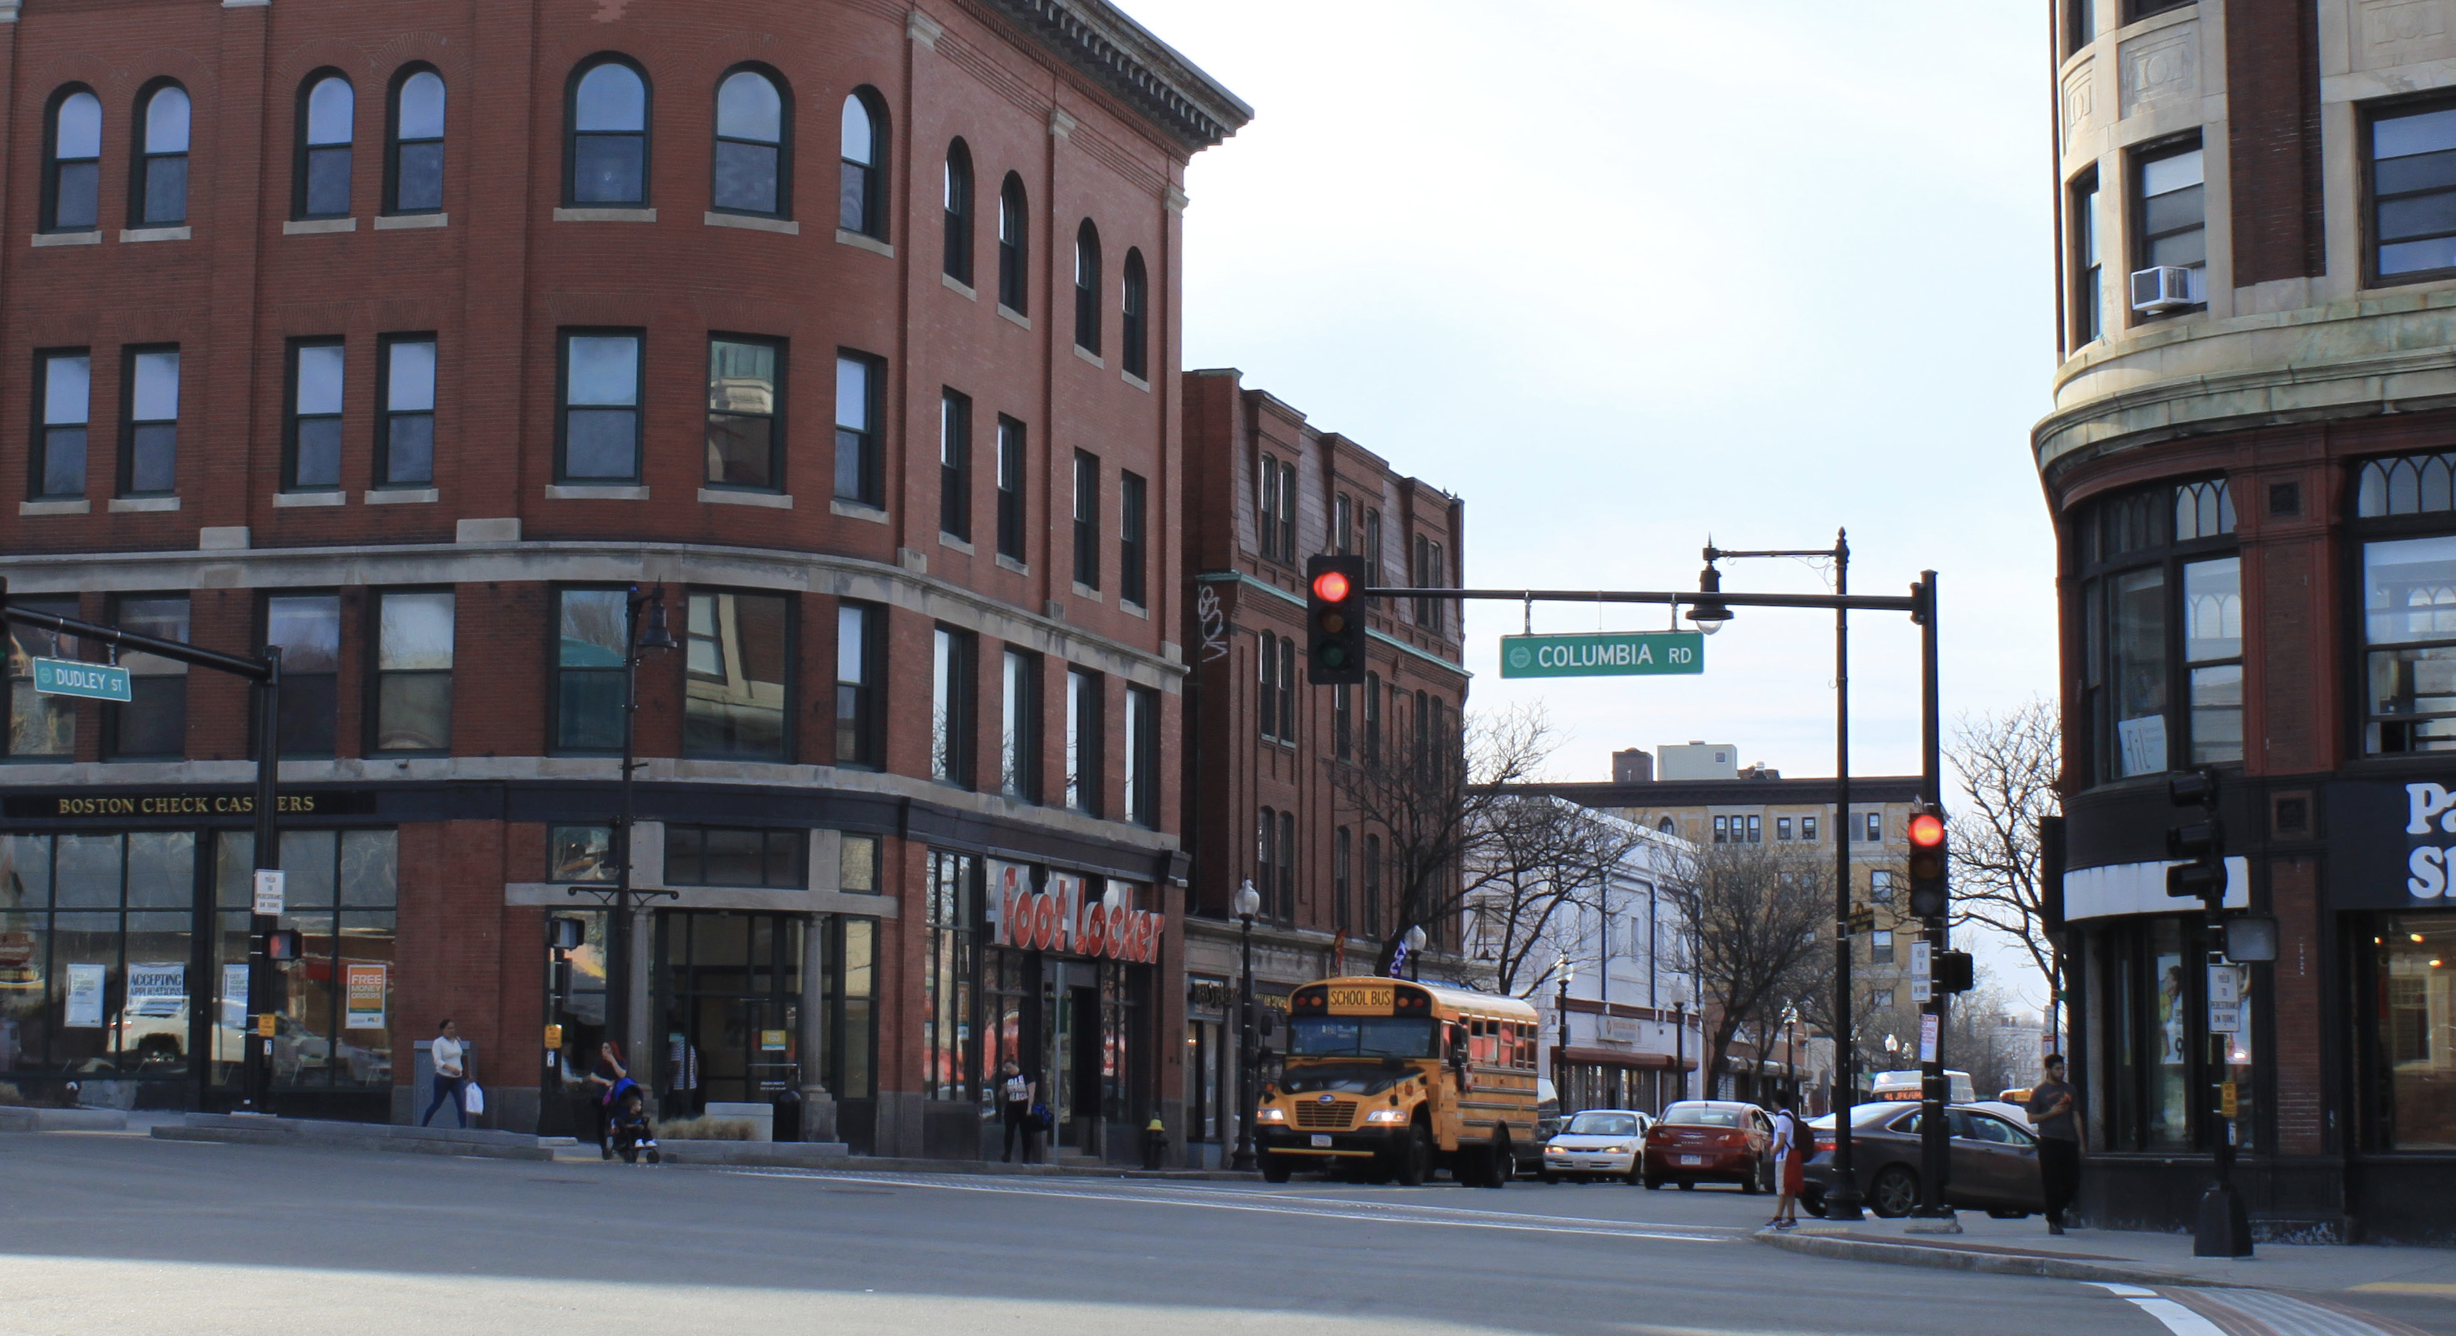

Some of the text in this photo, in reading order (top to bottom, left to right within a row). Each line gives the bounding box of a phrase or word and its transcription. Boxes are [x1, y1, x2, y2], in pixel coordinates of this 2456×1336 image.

[1538, 644, 1692, 668] COLUMBIA RD
[56, 668, 122, 692] DUDLEY ST
[59, 798, 135, 814] BOSTON
[141, 796, 209, 813] CHECK
[130, 973, 182, 986] ACCEPTING
[351, 974, 382, 985] FREE
[129, 986, 183, 997] APPLICATIONS
[1331, 990, 1391, 1006] SCHOOL BUS
